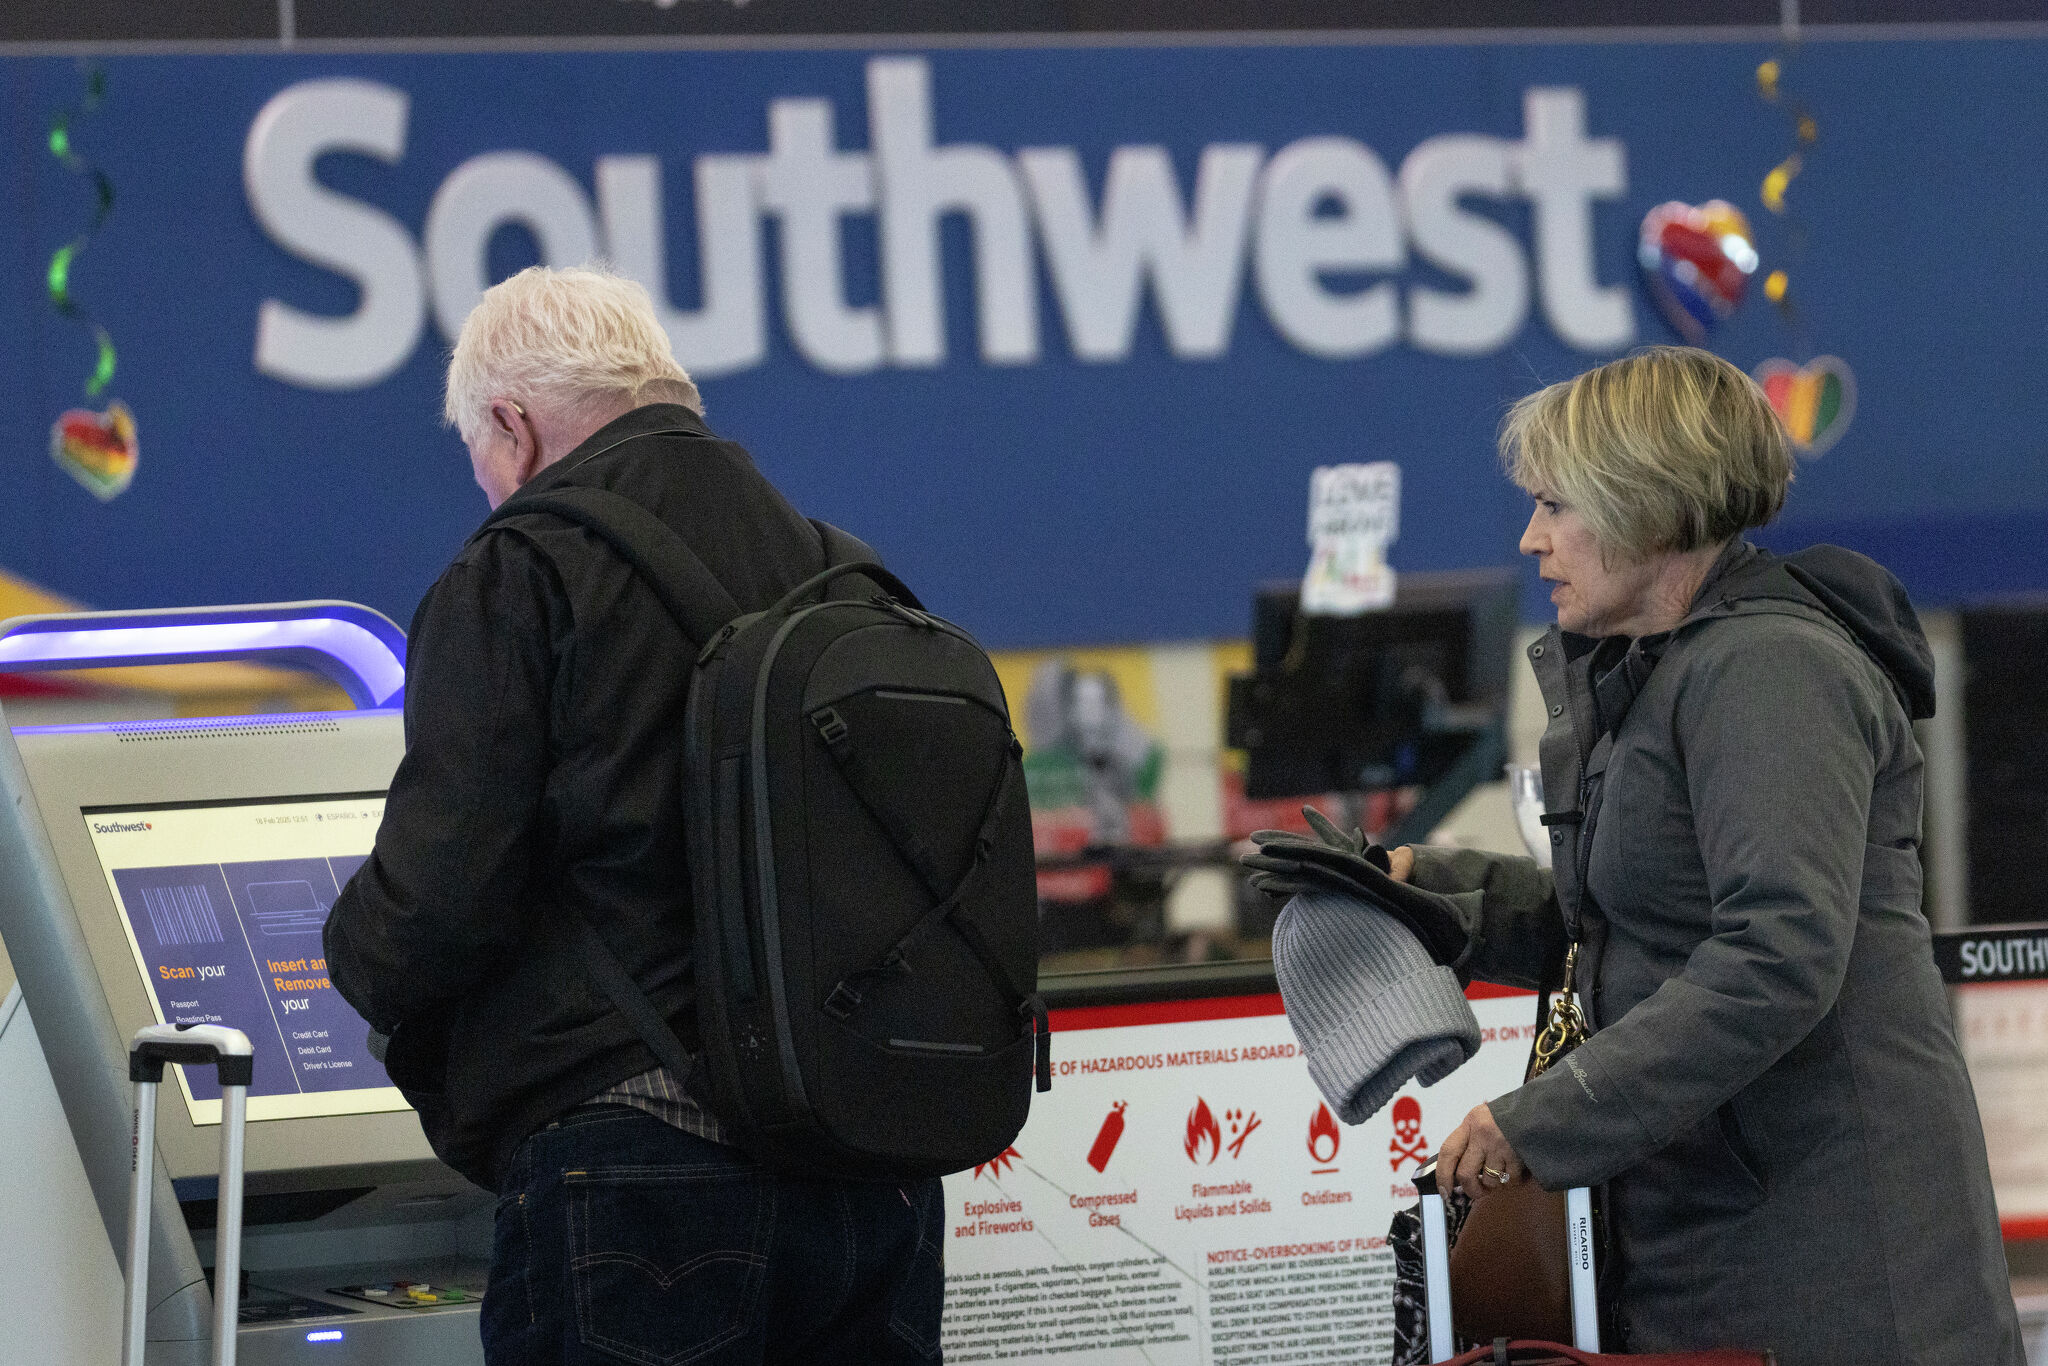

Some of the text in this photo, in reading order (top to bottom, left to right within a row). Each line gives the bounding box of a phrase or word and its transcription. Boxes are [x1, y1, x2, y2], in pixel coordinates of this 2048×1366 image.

[244, 56, 1636, 390] Southwest
[94, 821, 146, 833] Southwest
[267, 957, 328, 973] Insert an
[1961, 938, 2048, 976] SOUTH
[159, 964, 226, 981] Scan your
[273, 977, 331, 992] Remove
[170, 999, 200, 1009] Passport
[281, 998, 309, 1015] your
[176, 1013, 222, 1023] Boarding Pass
[292, 1029, 329, 1039] Credit Card
[1500, 1026, 1519, 1042] ON
[1521, 1024, 1536, 1040] YO
[297, 1045, 332, 1055] Debit Card
[303, 1060, 353, 1070] Driver's License
[1060, 1060, 1077, 1076] OF
[1081, 1053, 1163, 1075] HAZARDOUS
[1166, 1047, 1238, 1068] MATERIALS
[1241, 1043, 1295, 1062] ABOARD
[1192, 1179, 1252, 1199] Flammable
[1301, 1189, 1353, 1207] Oxidizers
[964, 1199, 1023, 1218] Explosives
[1069, 1189, 1138, 1210] Compressed
[1174, 1198, 1273, 1223] Liquids and Solids
[955, 1218, 1034, 1238] and Fireworks
[1088, 1212, 1121, 1228] Gases
[1338, 1239, 1351, 1253] OF
[1355, 1236, 1387, 1251] FLIGH
[1580, 1217, 1589, 1270] RICARDO
[964, 1272, 981, 1281] such
[1026, 1266, 1049, 1278] paints,
[1089, 1262, 1114, 1272] oxygen
[1082, 1275, 1104, 1286] power
[1131, 1268, 1160, 1279] external
[954, 1298, 986, 1309] batteries
[1001, 1293, 1039, 1307] prohibited
[1050, 1289, 1078, 1299] checked
[1115, 1282, 1144, 1293] Portable
[1147, 1279, 1182, 1290] electronic
[962, 1313, 990, 1324] carryon
[1033, 1305, 1046, 1315] this
[1055, 1303, 1068, 1313] not
[1102, 1298, 1118, 1308] such
[1121, 1296, 1146, 1306] devices
[1148, 1294, 1166, 1304] must
[1167, 1293, 1177, 1302] be
[960, 1325, 985, 1338] special
[986, 1321, 1025, 1335] exceptions
[1026, 1320, 1037, 1329] for
[1039, 1318, 1058, 1328] small
[1059, 1314, 1094, 1328] quantities
[1129, 1309, 1146, 1319] fluid
[968, 1337, 999, 1350] smoking
[1000, 1334, 1034, 1345] materials
[1055, 1330, 1076, 1342] safety
[1111, 1326, 1143, 1335] common
[995, 1349, 1008, 1359] See
[1020, 1346, 1043, 1356] airline
[1045, 1341, 1096, 1356] representative
[1097, 1339, 1107, 1349] for
[1110, 1336, 1145, 1347] additional
